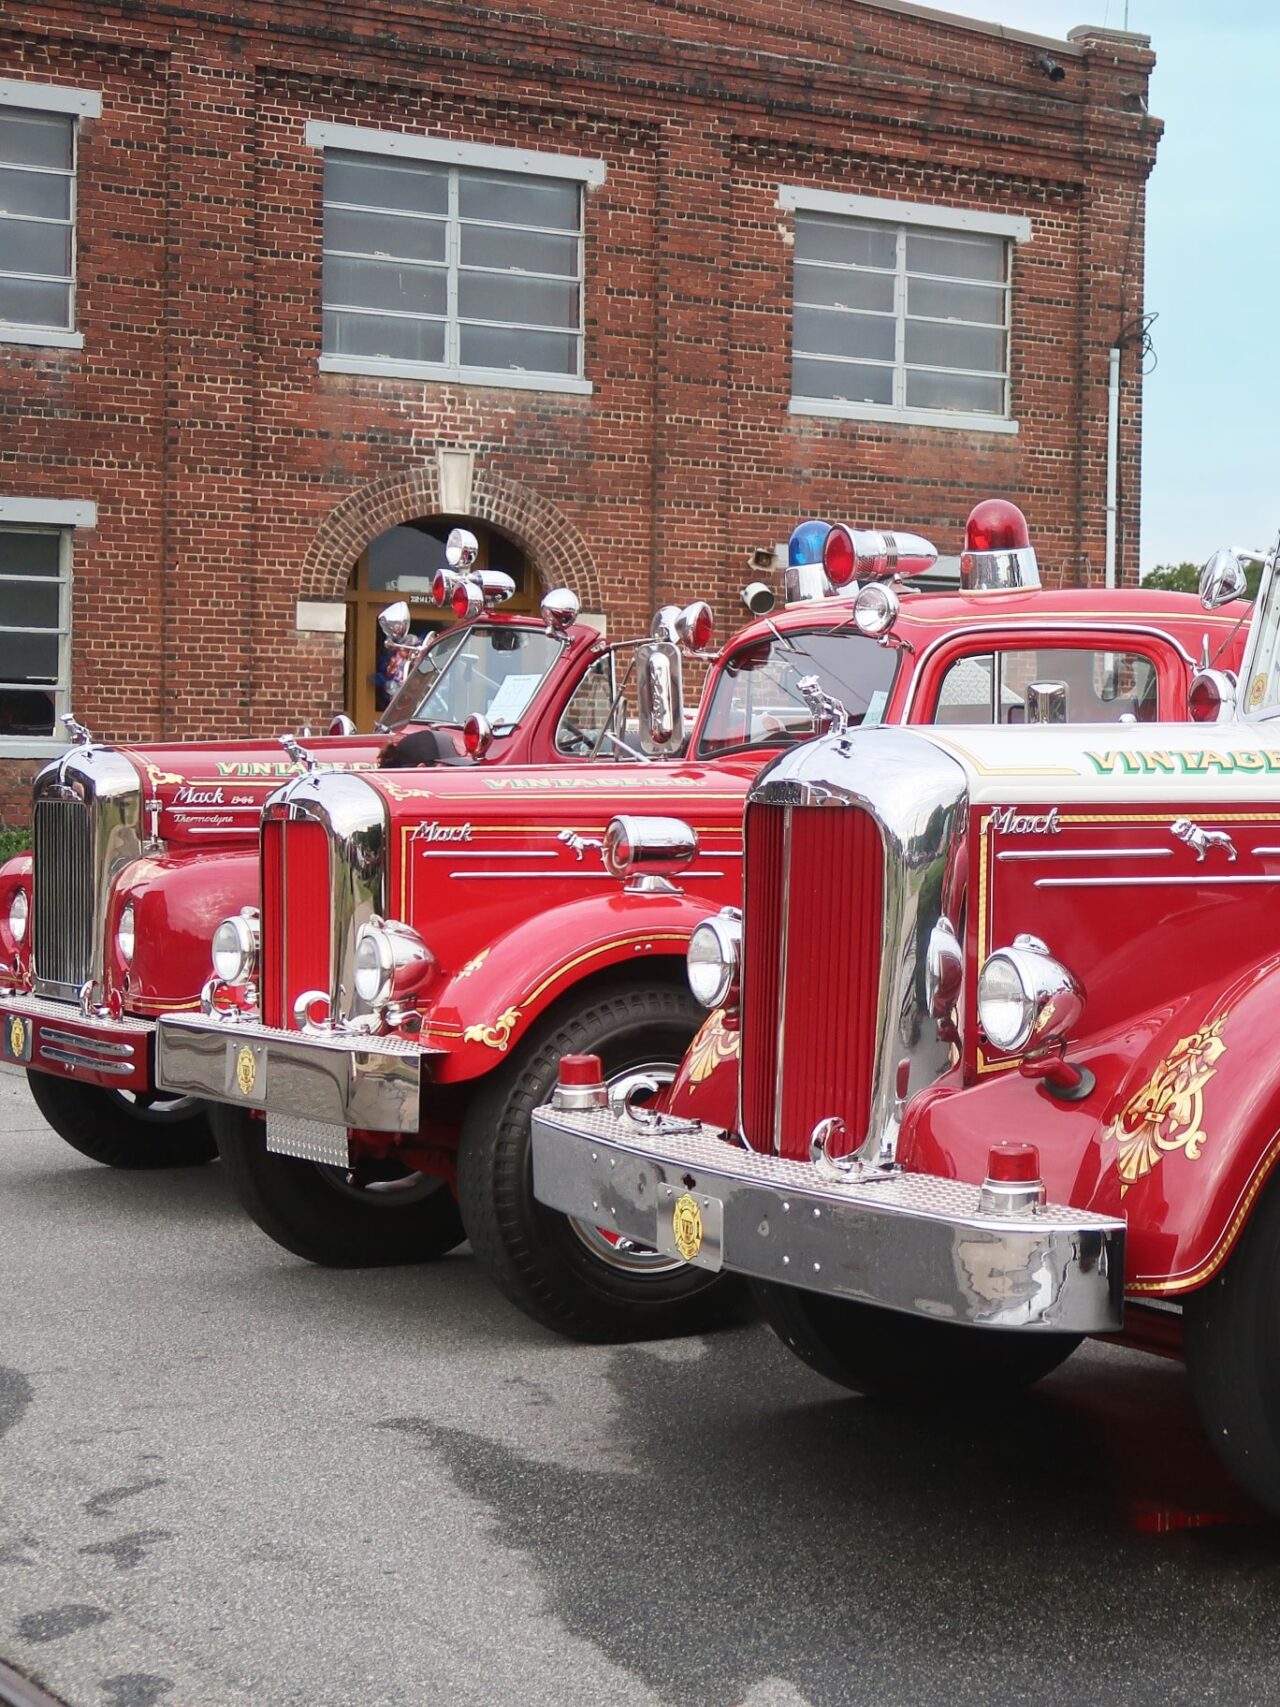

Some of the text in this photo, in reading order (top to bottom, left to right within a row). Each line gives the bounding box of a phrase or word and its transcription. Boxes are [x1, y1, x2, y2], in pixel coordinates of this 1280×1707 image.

[483, 777, 640, 789] VINTAGE
[172, 786, 224, 804] Mack
[409, 820, 473, 842] Mack
[979, 806, 1062, 836] Mack
